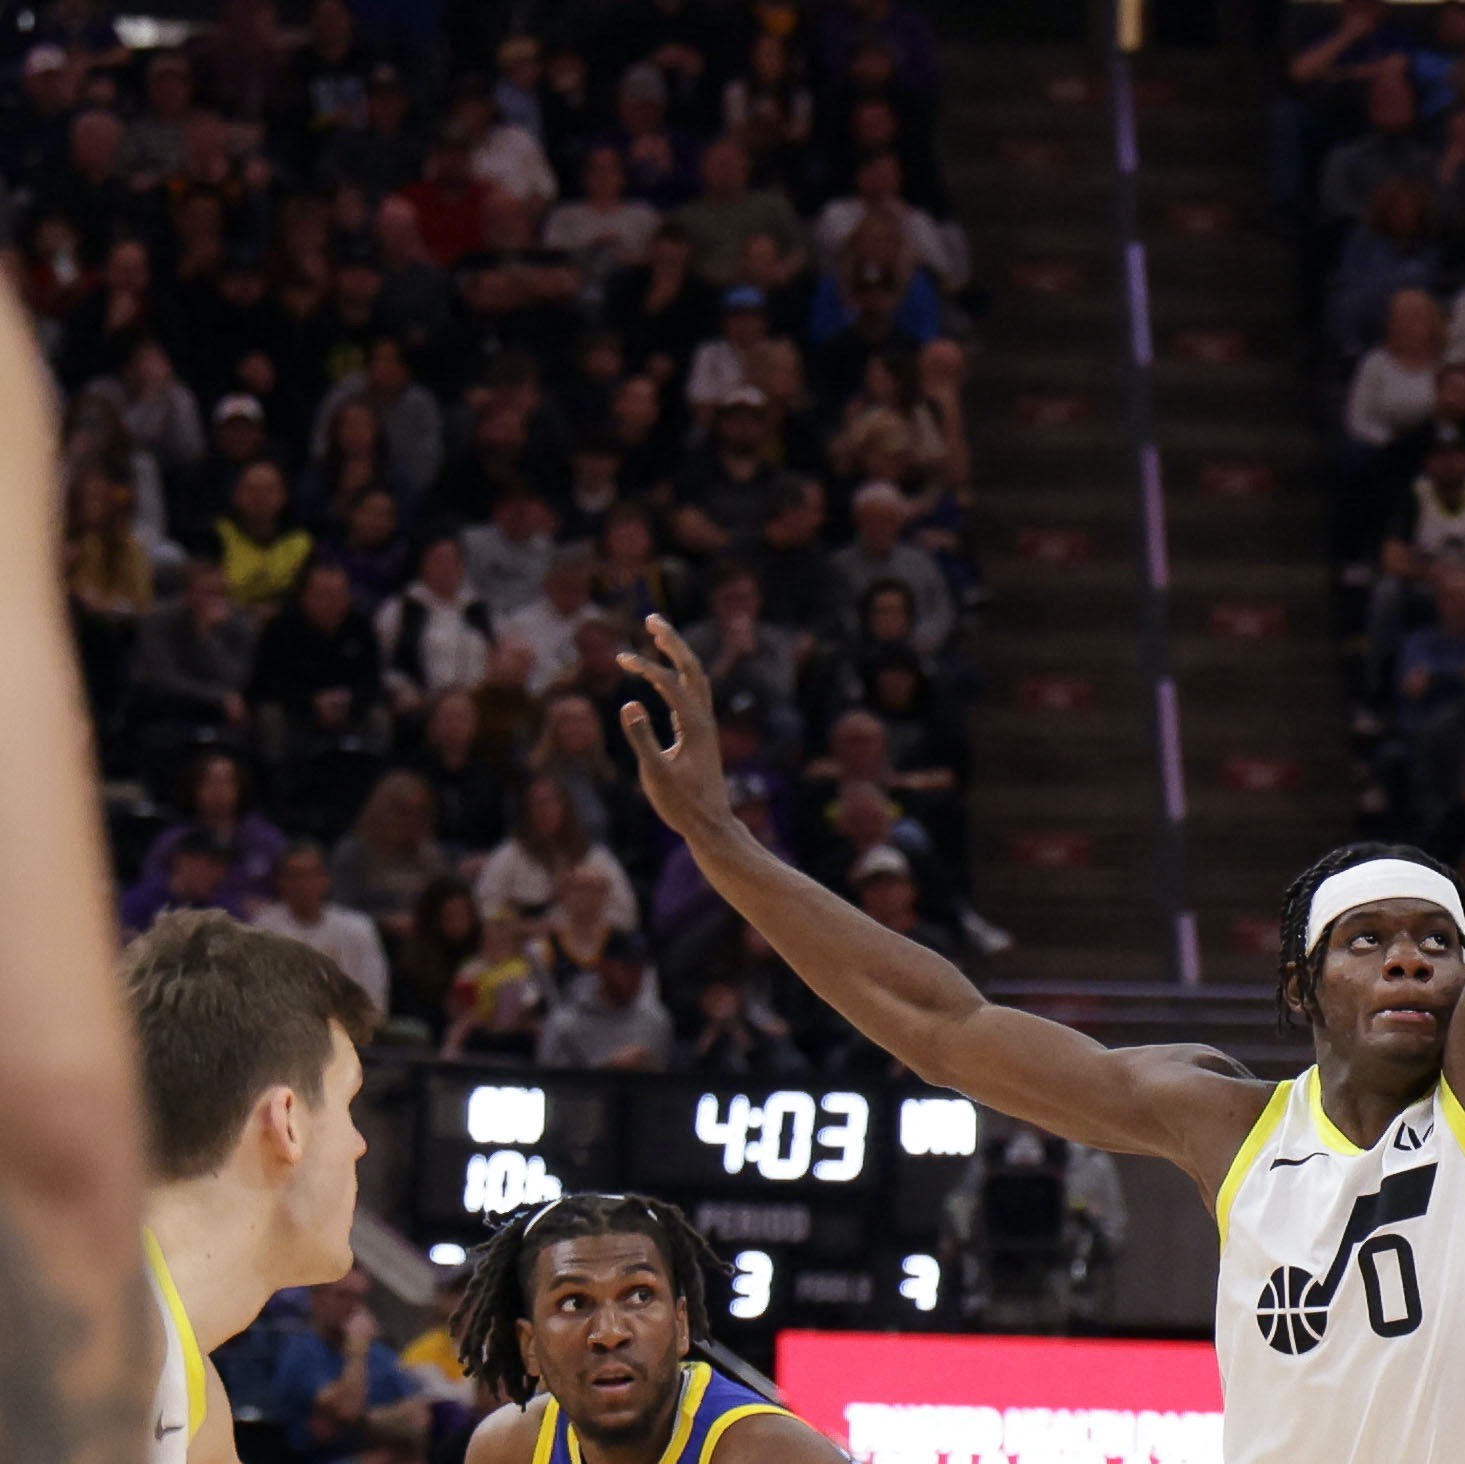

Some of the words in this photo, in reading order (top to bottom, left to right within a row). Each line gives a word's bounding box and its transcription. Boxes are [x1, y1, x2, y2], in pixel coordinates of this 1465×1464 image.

[695, 1090, 869, 1182] 4:03
[730, 1250, 774, 1319] 3
[1358, 1234, 1423, 1338] 0
